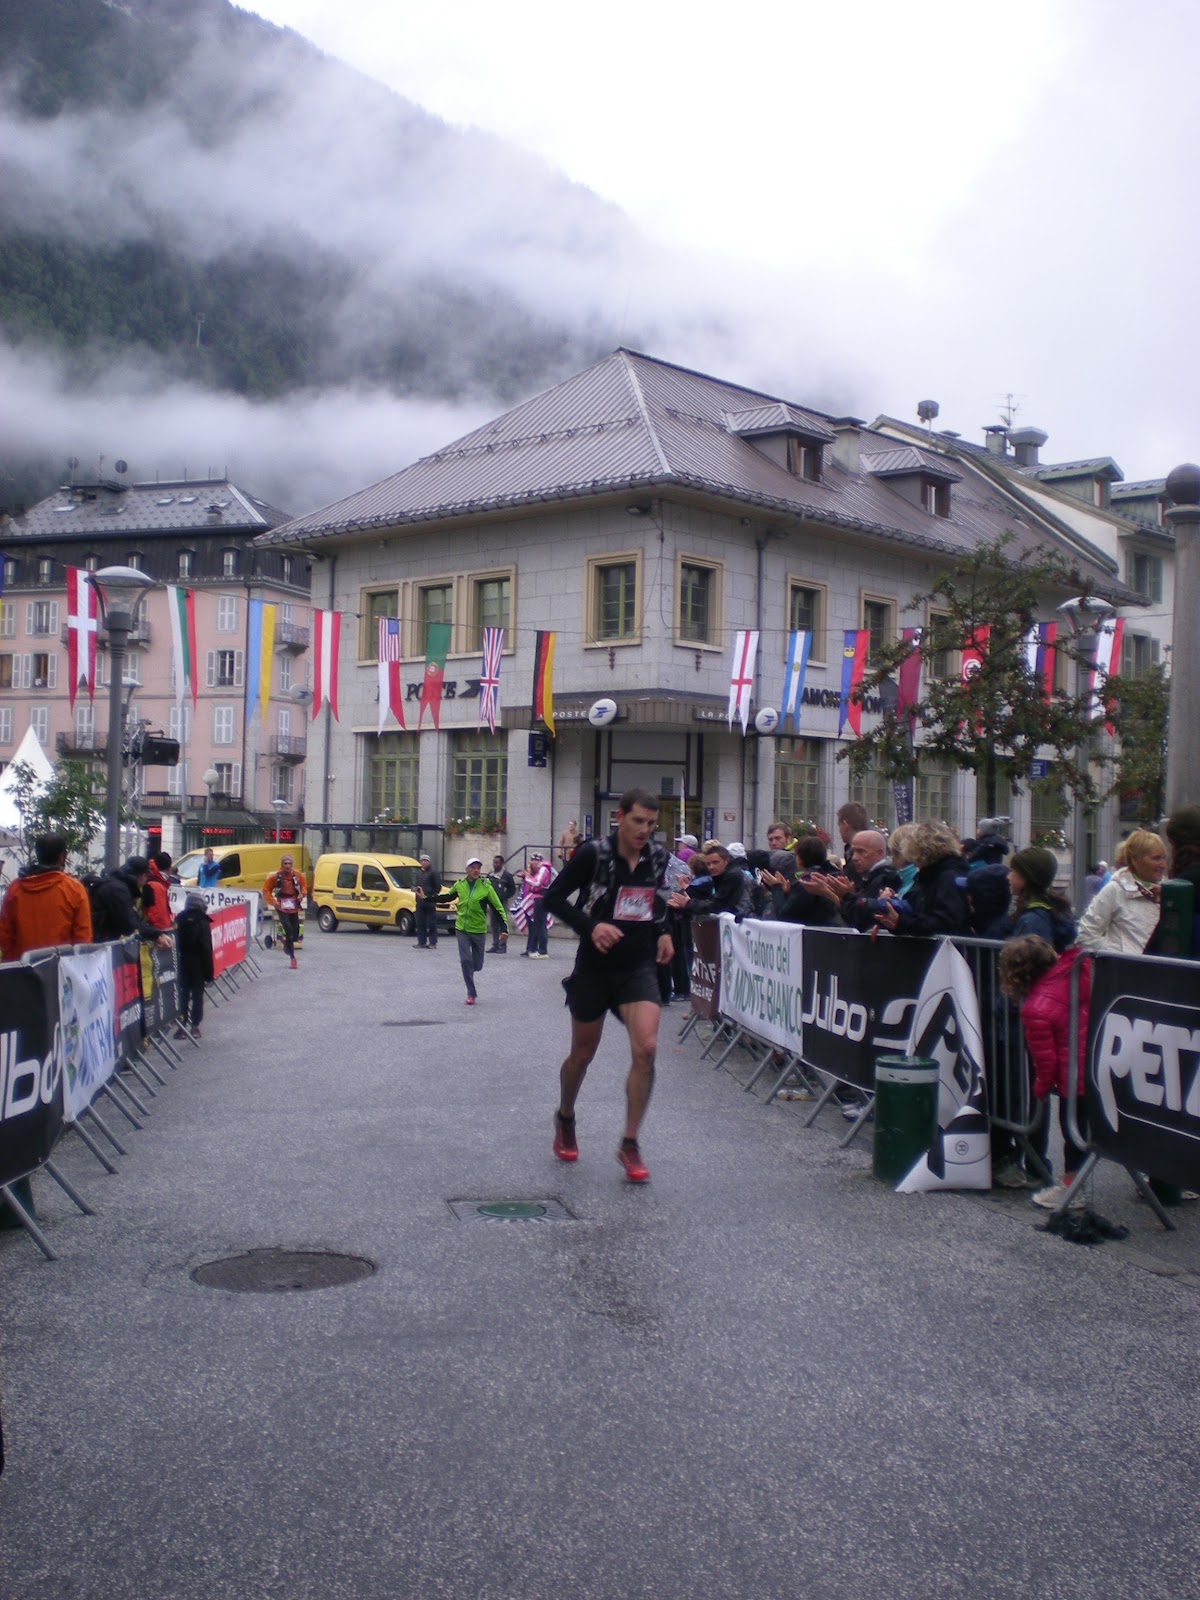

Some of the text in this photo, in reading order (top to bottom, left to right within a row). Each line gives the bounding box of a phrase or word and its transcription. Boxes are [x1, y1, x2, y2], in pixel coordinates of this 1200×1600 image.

[552, 710, 587, 718] POSTE
[776, 935, 791, 976] del
[733, 967, 765, 1020] MONTE
[1097, 1012, 1200, 1133] PET
